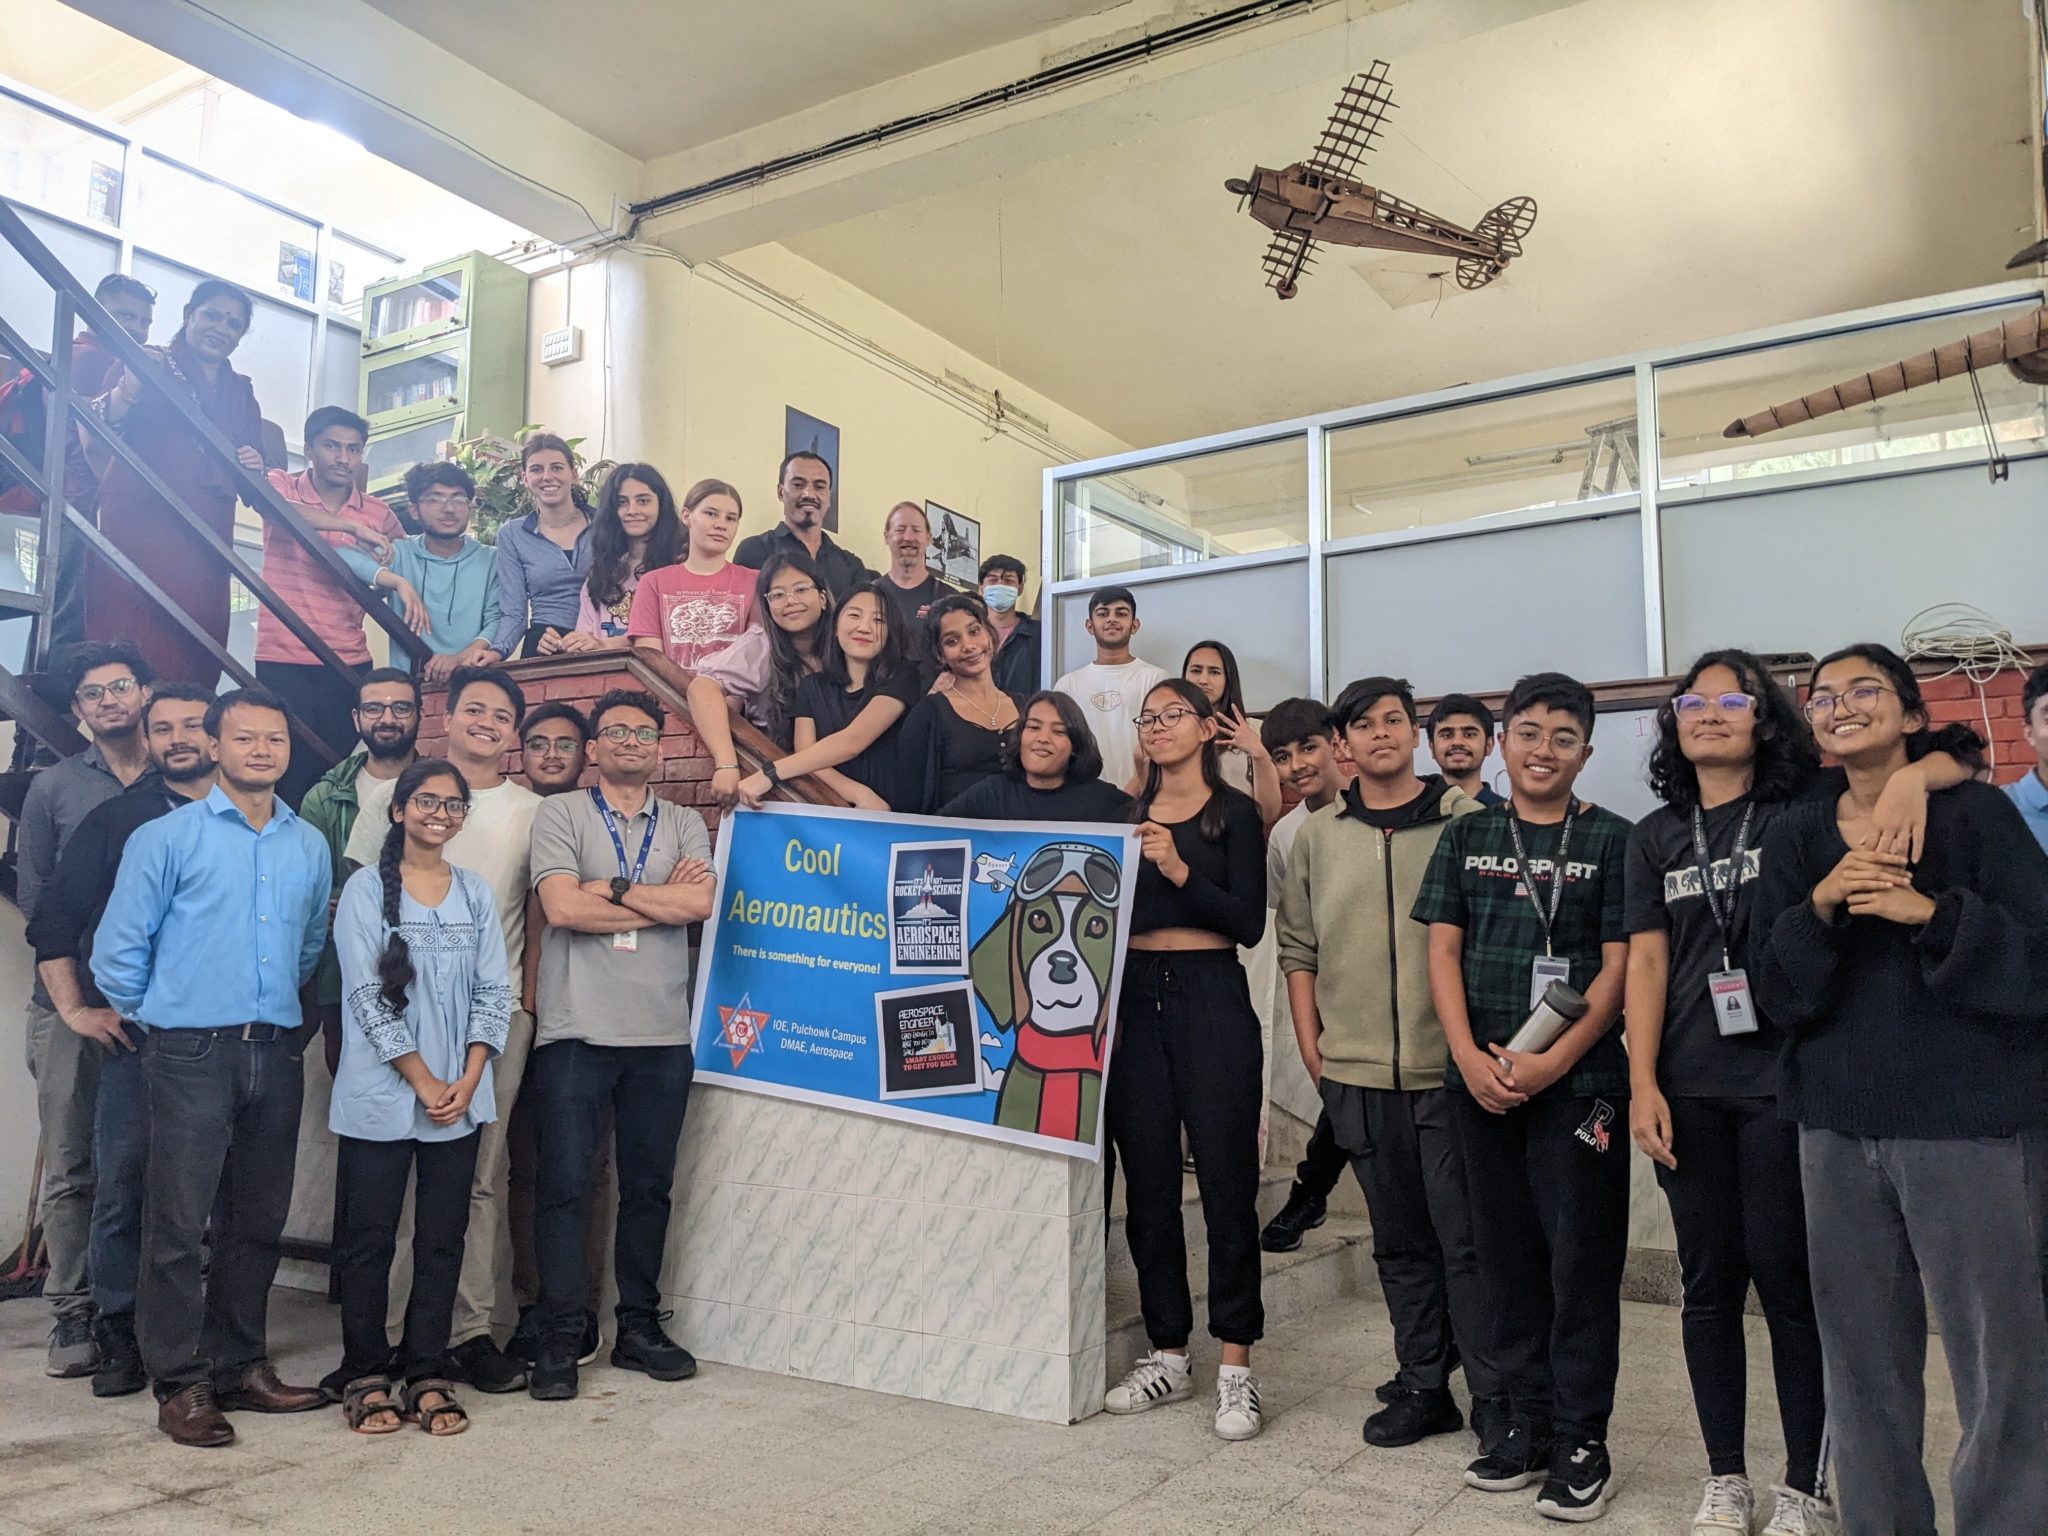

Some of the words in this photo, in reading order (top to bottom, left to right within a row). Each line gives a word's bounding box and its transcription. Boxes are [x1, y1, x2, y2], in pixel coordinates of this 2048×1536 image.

[785, 838, 841, 876] Cool
[1465, 856, 1519, 873] POLO
[1527, 859, 1597, 879] SPRT
[895, 885, 922, 896] ROCKET
[932, 884, 961, 896] SCIENCE
[728, 889, 887, 940] Aeronautics
[897, 925, 959, 944] AEROSPACE
[732, 944, 757, 958] There
[759, 948, 767, 959] is
[768, 949, 816, 968] something
[817, 955, 831, 968] for
[833, 959, 880, 975] everyone!
[897, 945, 960, 960] ENGINEERING
[898, 1005, 944, 1019] AEROSPACE
[773, 1019, 789, 1033] IOE,
[791, 1022, 830, 1039] Pulchowk
[831, 1028, 867, 1045] Campus
[900, 1017, 934, 1030] ENGINEER
[780, 1037, 807, 1055] DMAE,
[809, 1043, 854, 1061] Aerospace
[905, 1056, 928, 1064] SMART
[928, 1053, 955, 1061] ENOUGH
[940, 1059, 957, 1067] BACK
[1580, 1098, 1614, 1133] P
[1574, 1128, 1597, 1146] POLO
